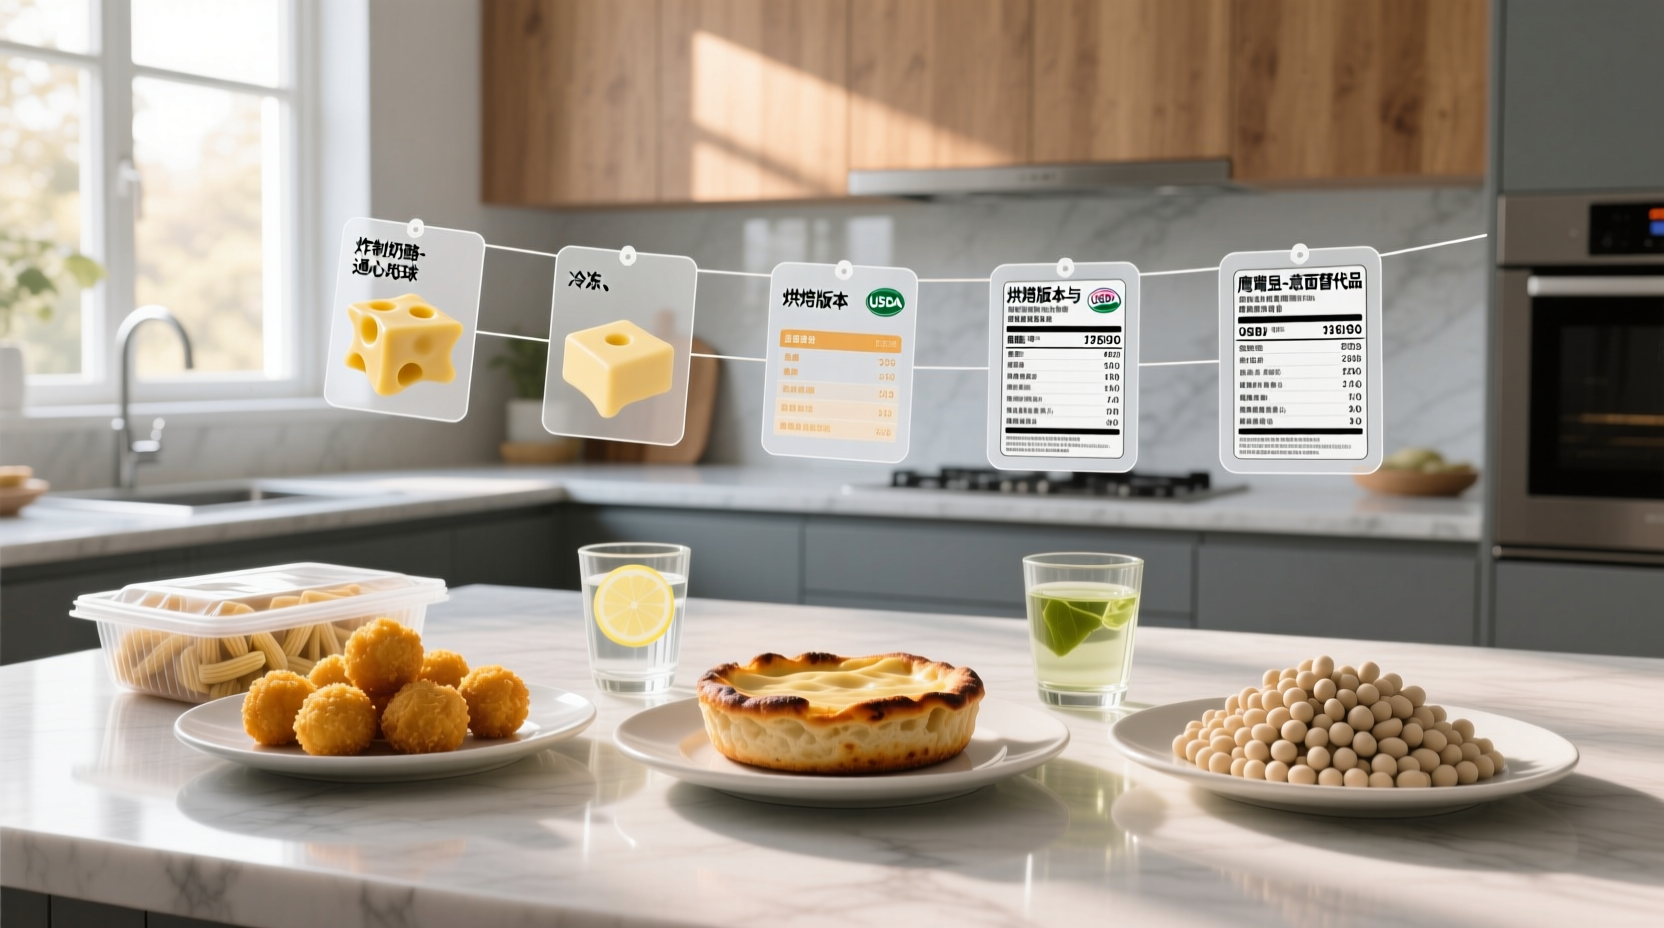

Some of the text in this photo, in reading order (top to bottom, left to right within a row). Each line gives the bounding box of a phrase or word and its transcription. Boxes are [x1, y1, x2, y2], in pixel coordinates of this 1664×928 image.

[782, 287, 849, 311] 烘焙版本
[869, 295, 903, 309] USDA
